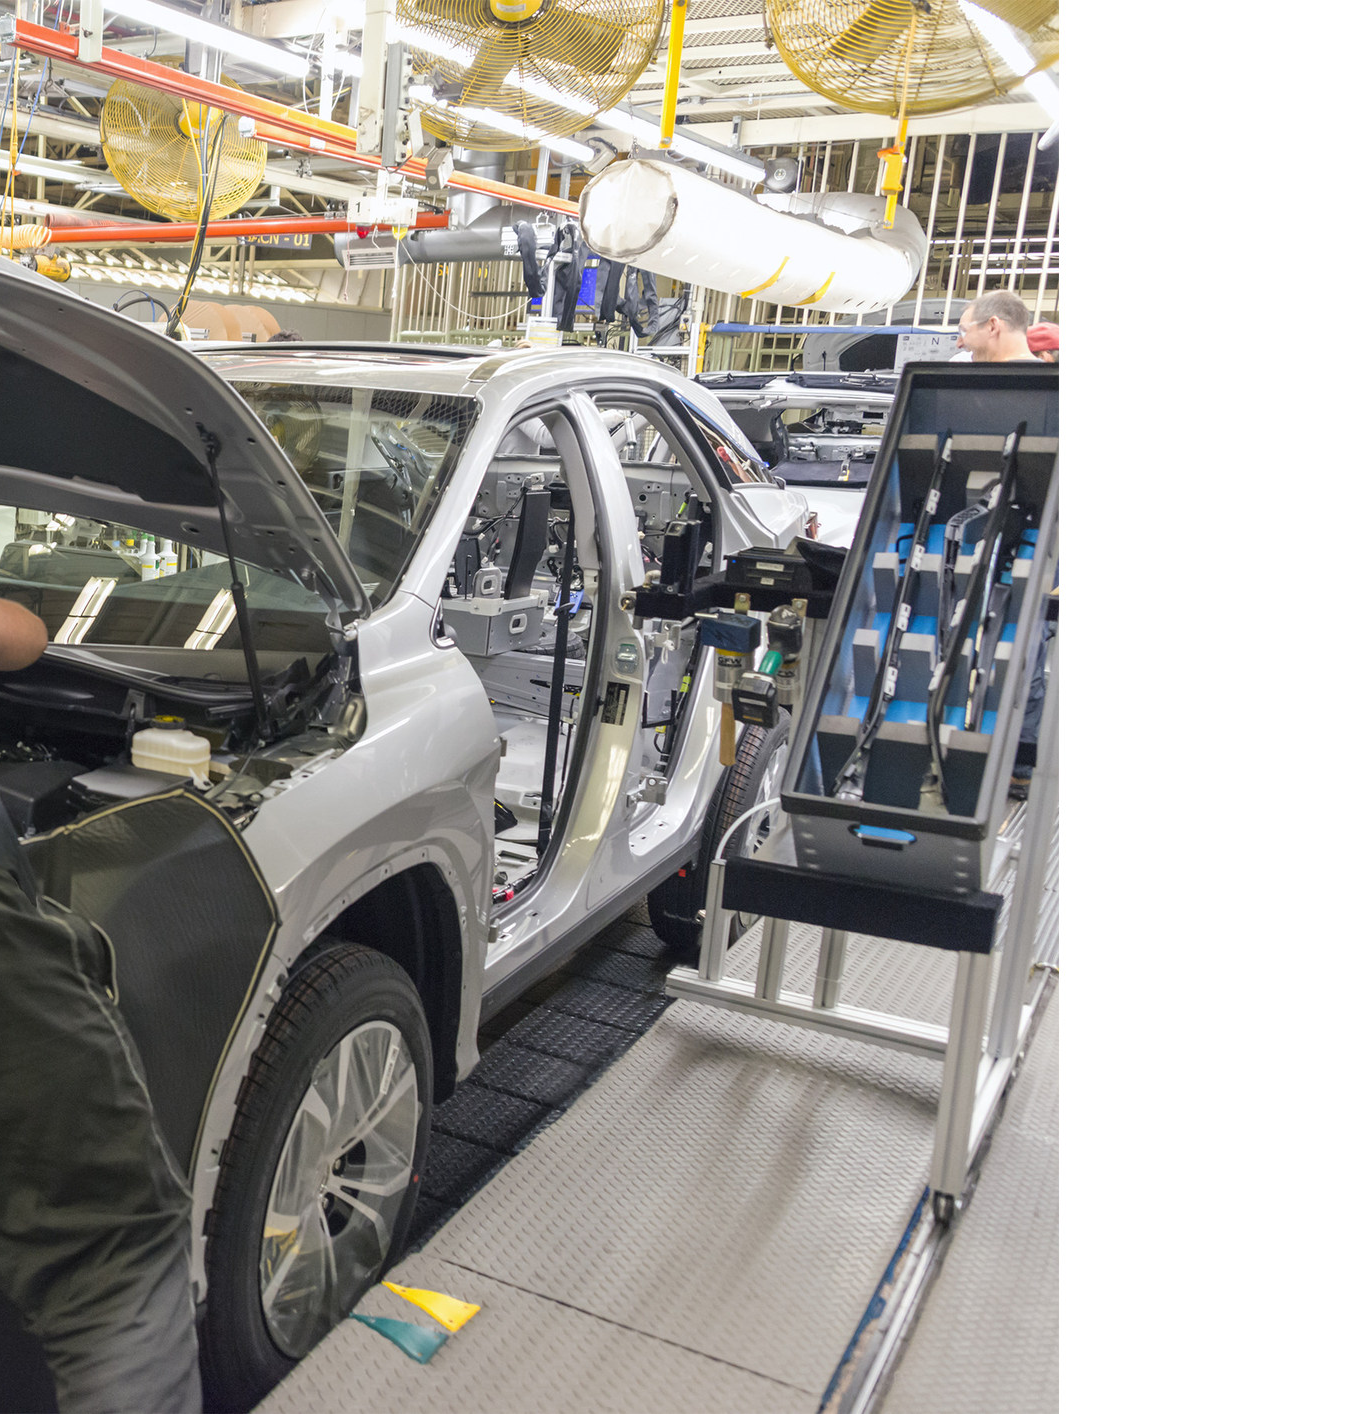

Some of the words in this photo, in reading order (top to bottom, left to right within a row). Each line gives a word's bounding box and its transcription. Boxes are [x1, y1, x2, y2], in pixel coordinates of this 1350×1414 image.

[355, 201, 361, 214] 1
[293, 233, 310, 247] 01
[931, 337, 940, 345] N
